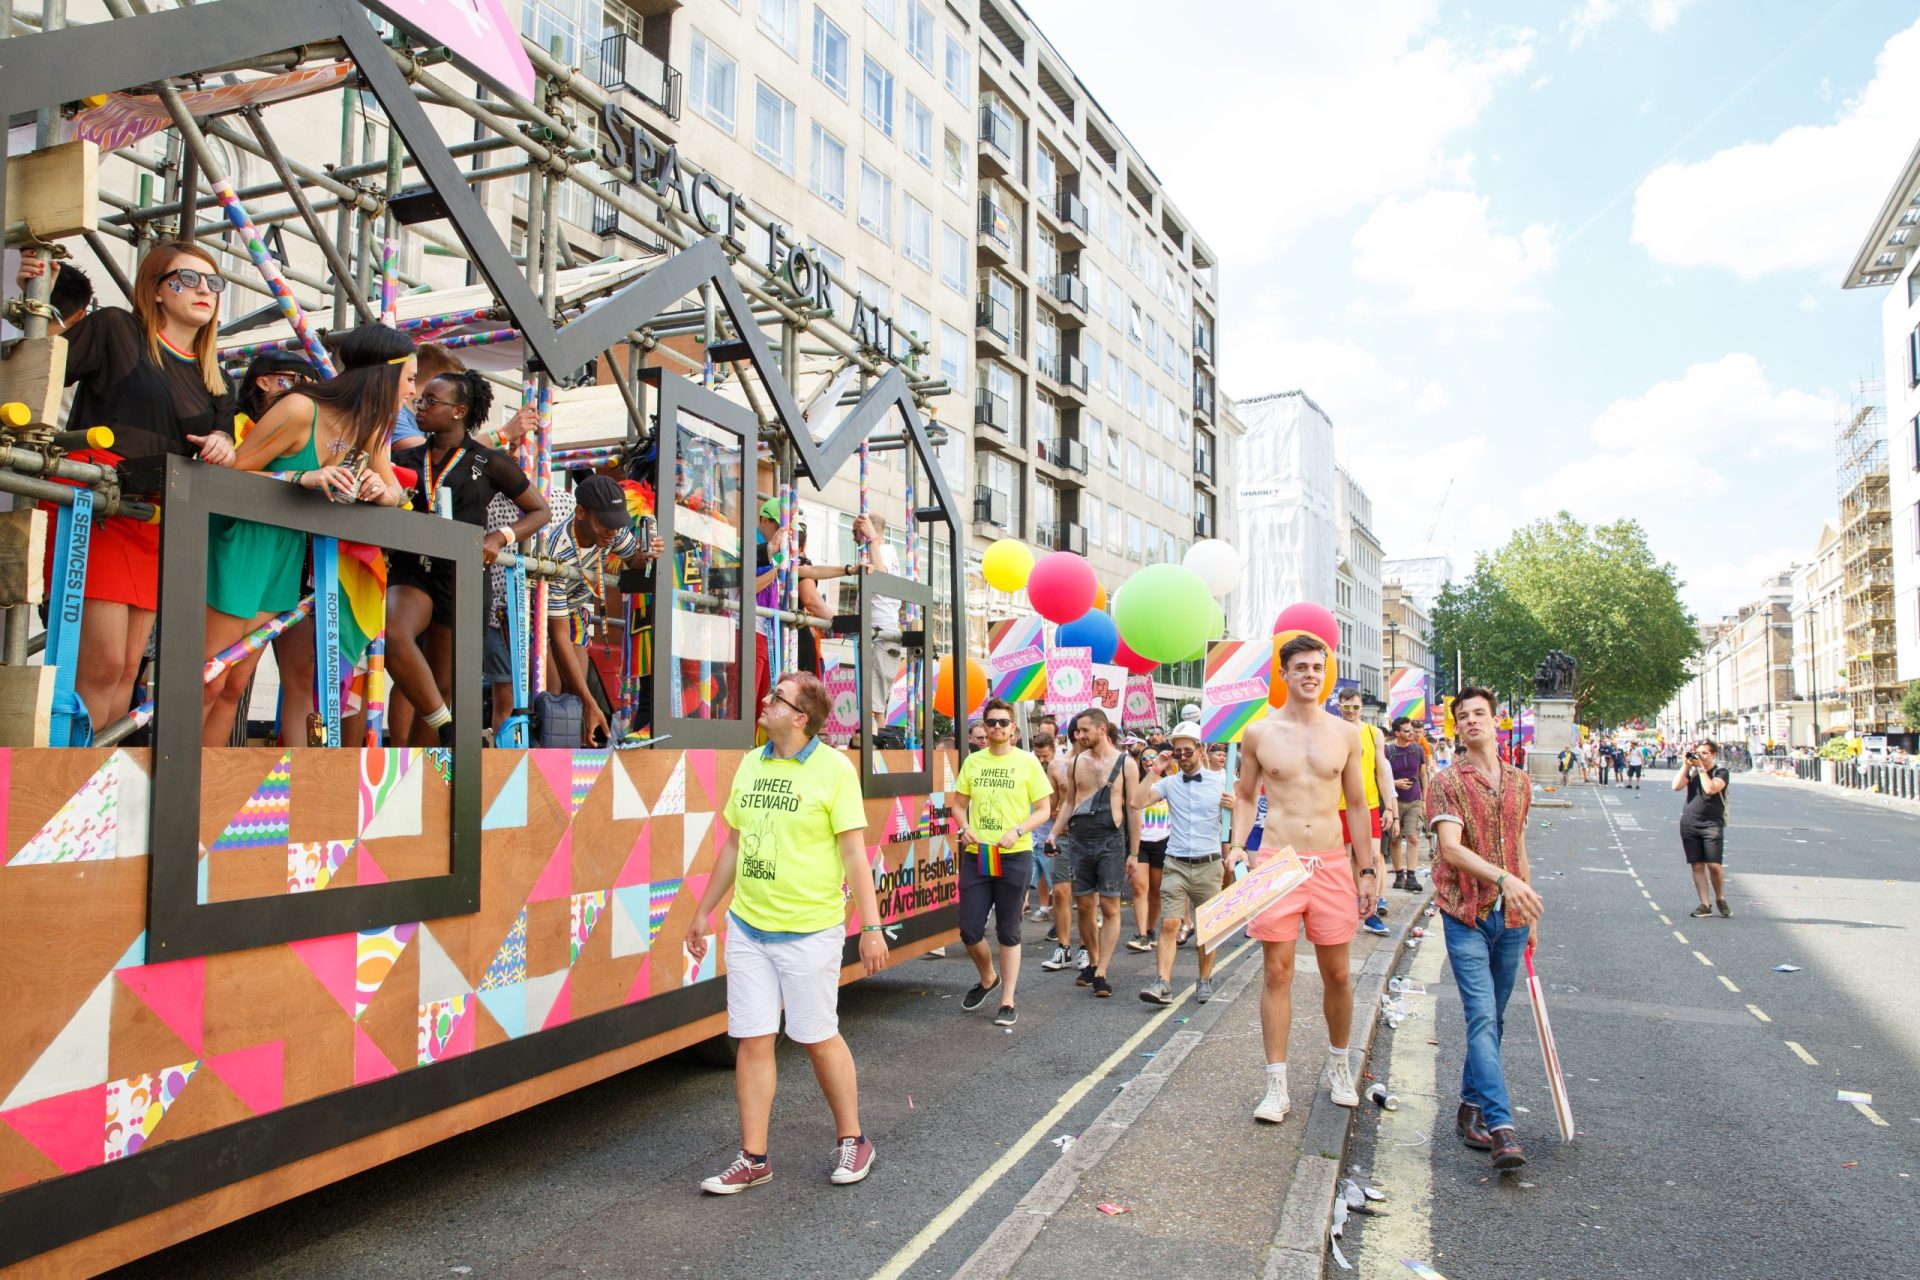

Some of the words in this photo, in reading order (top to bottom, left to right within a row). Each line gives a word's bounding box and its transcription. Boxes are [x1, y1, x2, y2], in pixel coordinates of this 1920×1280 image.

[602, 103, 746, 254] SPACE
[769, 222, 832, 309] FOR
[850, 293, 901, 364] ALL
[67, 513, 90, 590] SERVICES
[517, 572, 526, 613] MARINE
[64, 593, 82, 623] LTD
[328, 592, 338, 628] ROPE
[328, 631, 338, 641] &
[519, 617, 527, 669] SERVICES
[328, 644, 339, 694] MARINE
[832, 671, 855, 681] LOU
[1209, 686, 1262, 704] LGBT+
[329, 698, 340, 748] SERVIC
[974, 778, 1015, 789] STEWARD
[981, 768, 1010, 778] WHEEL
[753, 778, 793, 795] WHEEL
[740, 793, 799, 812] STEWARD
[930, 804, 952, 820] Hawkin
[1142, 806, 1170, 829] OV
[930, 822, 950, 837] Brown
[742, 864, 775, 880] LONDON
[744, 858, 764, 870] PRIDE
[766, 861, 776, 871] IN
[872, 863, 915, 894] London
[918, 852, 957, 883] Festival
[880, 890, 892, 918] of
[893, 881, 957, 915] Architecture
